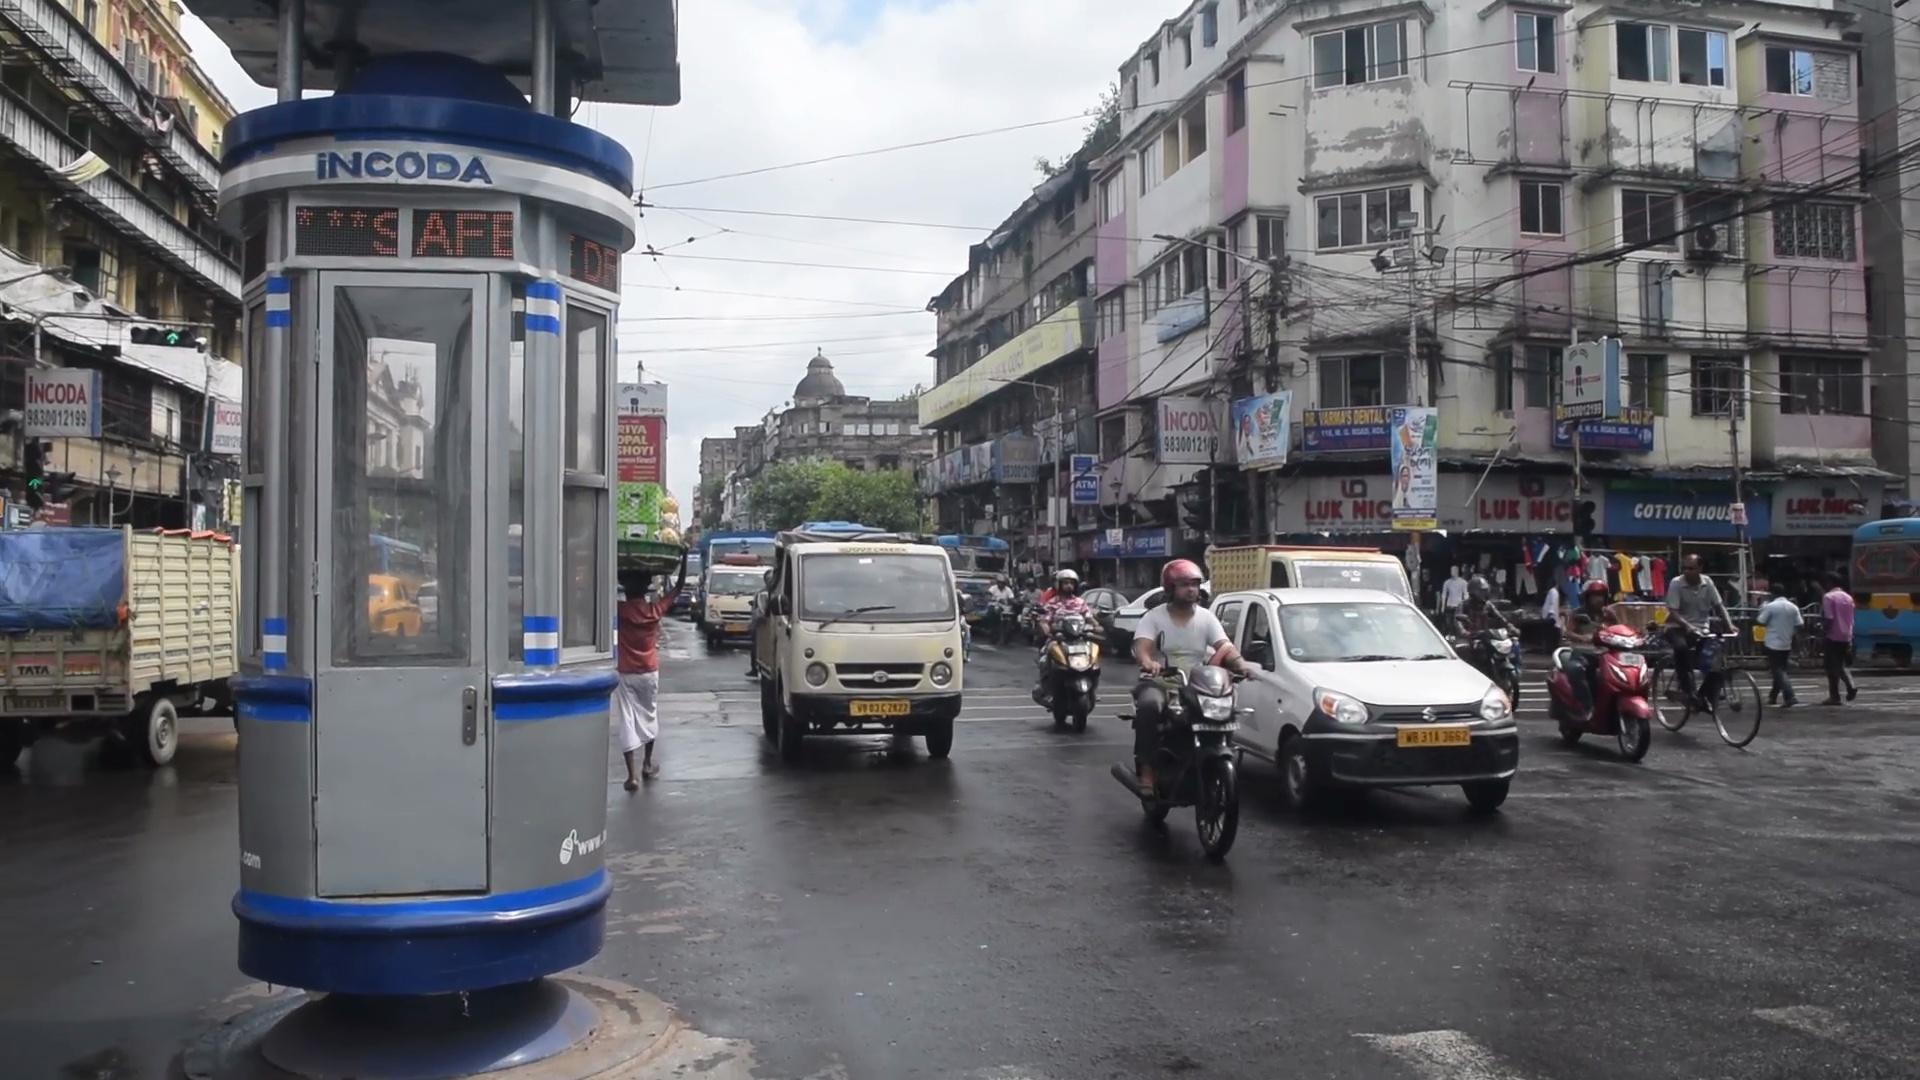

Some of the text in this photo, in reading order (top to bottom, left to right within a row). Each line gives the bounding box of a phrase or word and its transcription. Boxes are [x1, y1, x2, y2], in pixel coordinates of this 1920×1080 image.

[27, 409, 87, 427] 9830012199
[1075, 480, 1096, 489] ATM
[1305, 500, 1343, 520] LUK
[1479, 498, 1519, 520] LUK
[1634, 503, 1693, 520] COTTON
[18, 665, 49, 676] TATA
